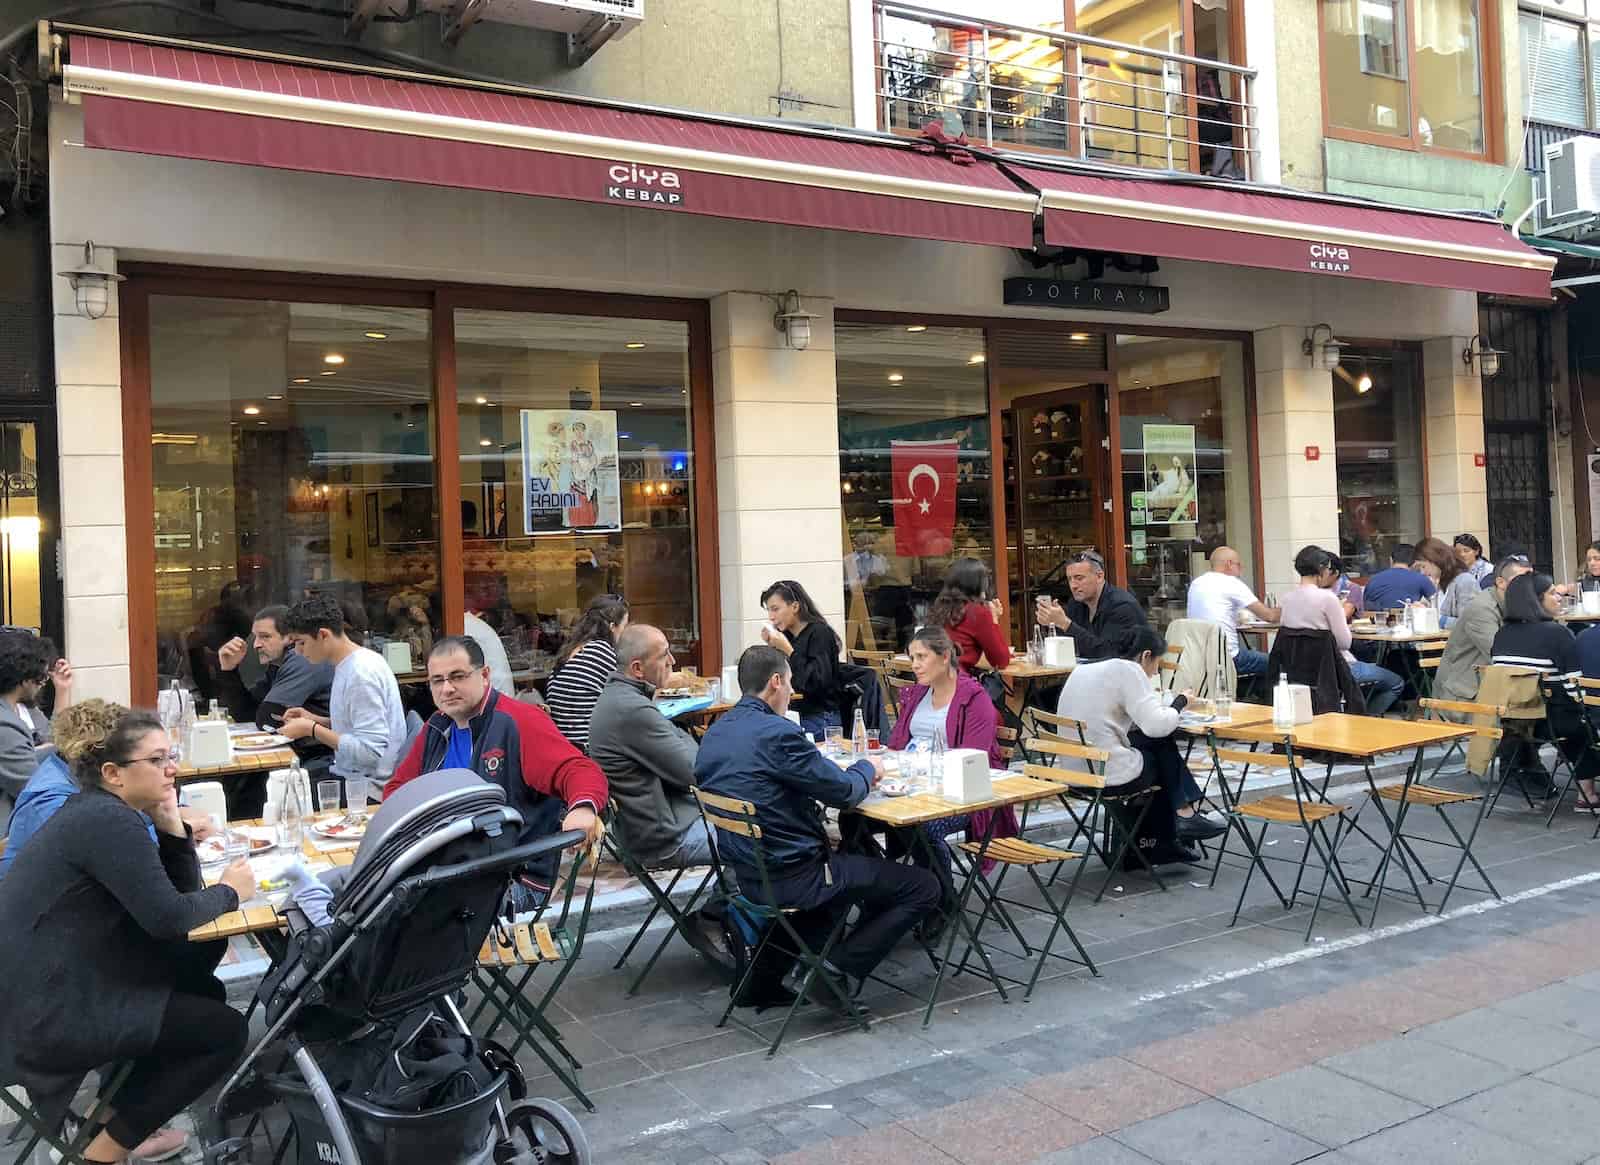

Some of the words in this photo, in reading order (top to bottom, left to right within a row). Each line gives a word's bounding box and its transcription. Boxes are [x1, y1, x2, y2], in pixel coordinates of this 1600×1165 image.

[609, 187, 680, 203] KEBAP
[1311, 261, 1350, 272] KEBAP
[1027, 284, 1161, 305] SOFRASI
[531, 478, 550, 492] EV
